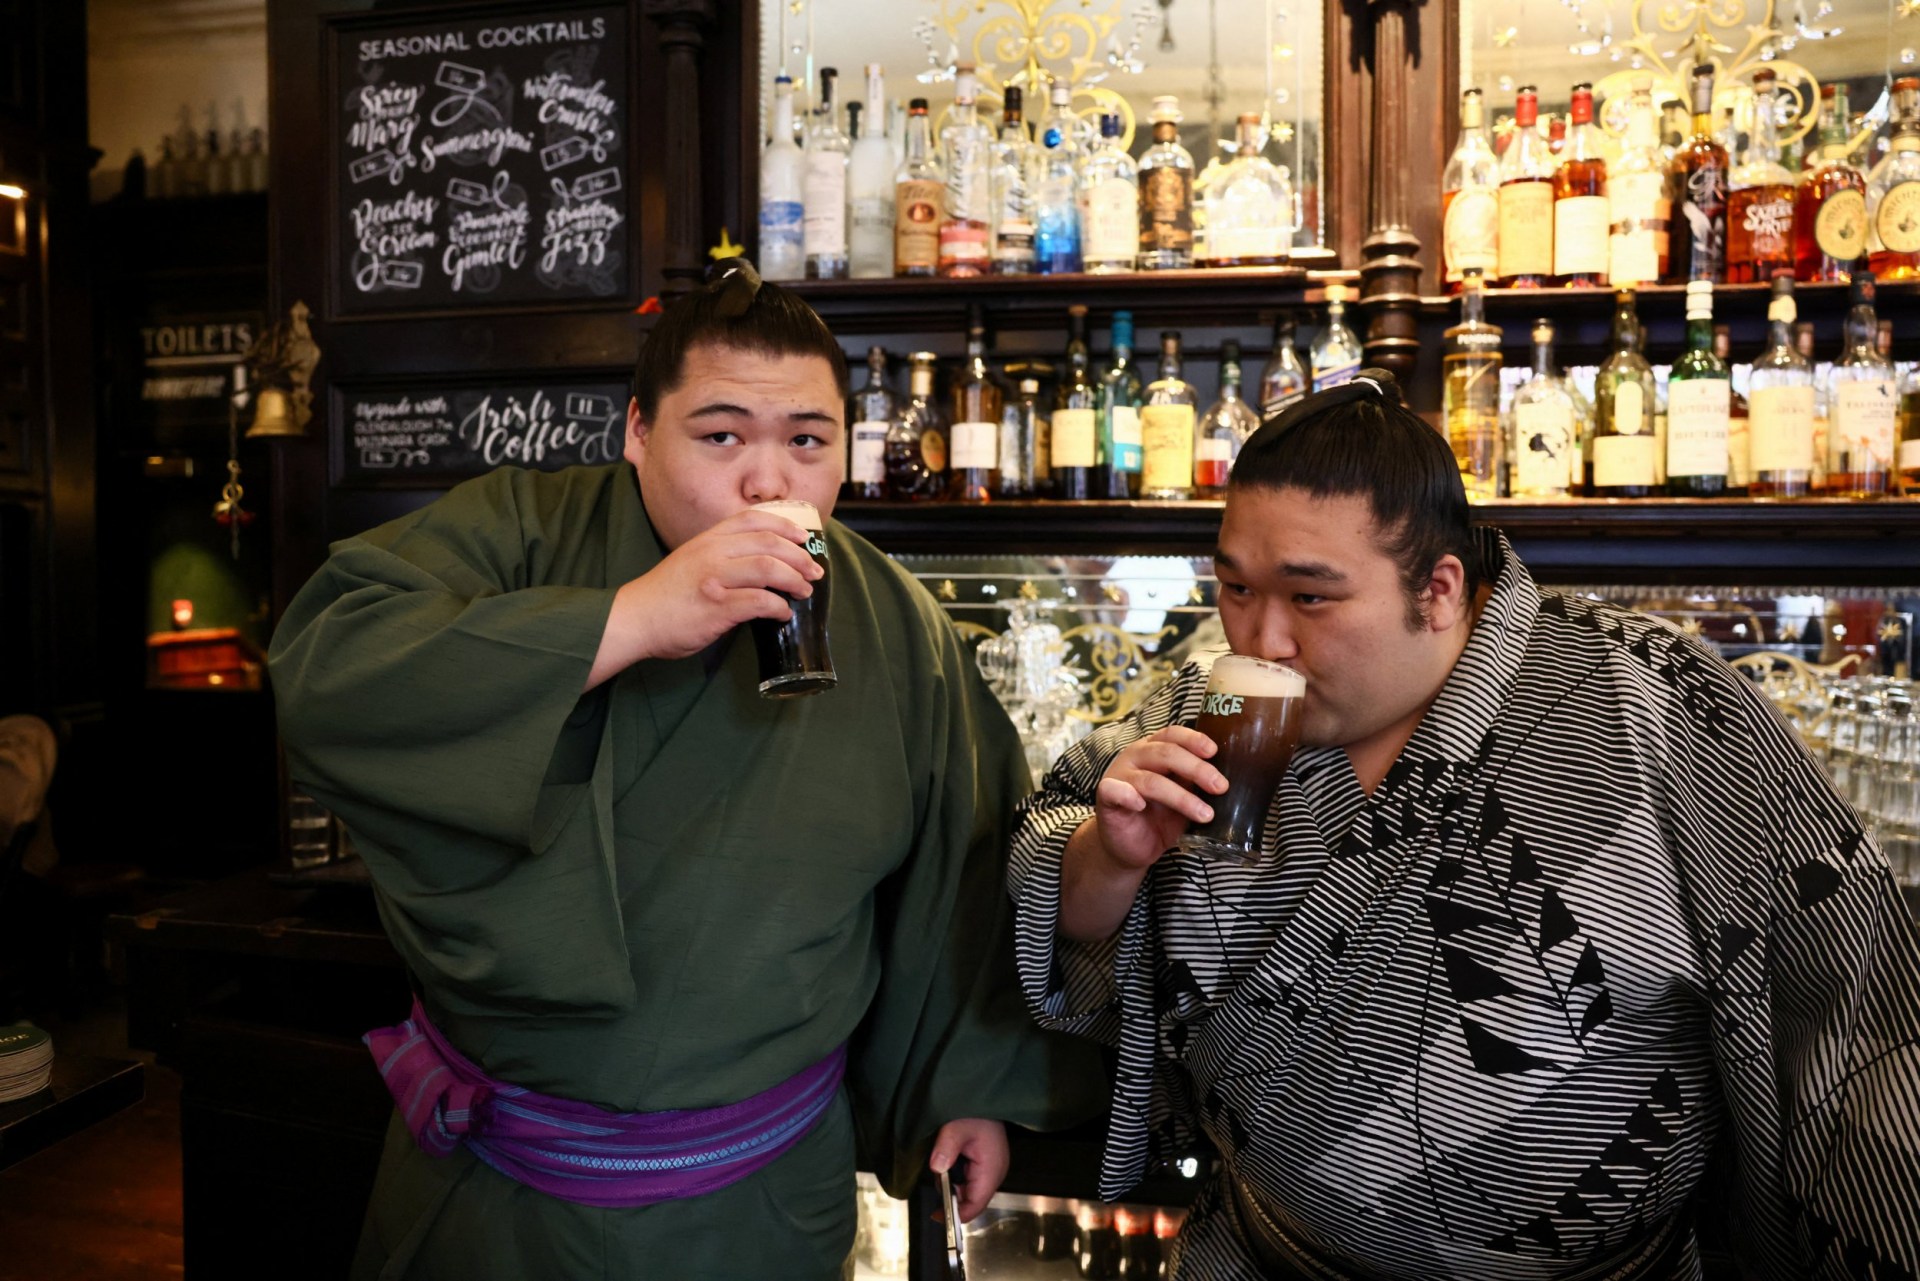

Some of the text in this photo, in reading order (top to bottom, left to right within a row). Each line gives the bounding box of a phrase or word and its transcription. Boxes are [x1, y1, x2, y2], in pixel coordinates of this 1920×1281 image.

[358, 17, 606, 61] SEASONAL COCKTAILS
[360, 81, 425, 119] Spicy
[346, 113, 421, 155] Mary
[349, 190, 440, 238] Peaches
[442, 237, 528, 291] Gimlet
[141, 323, 251, 355] TOILETS
[458, 390, 555, 451] Irish
[484, 421, 585, 466] Coffee
[1201, 693, 1245, 717] ORGE
